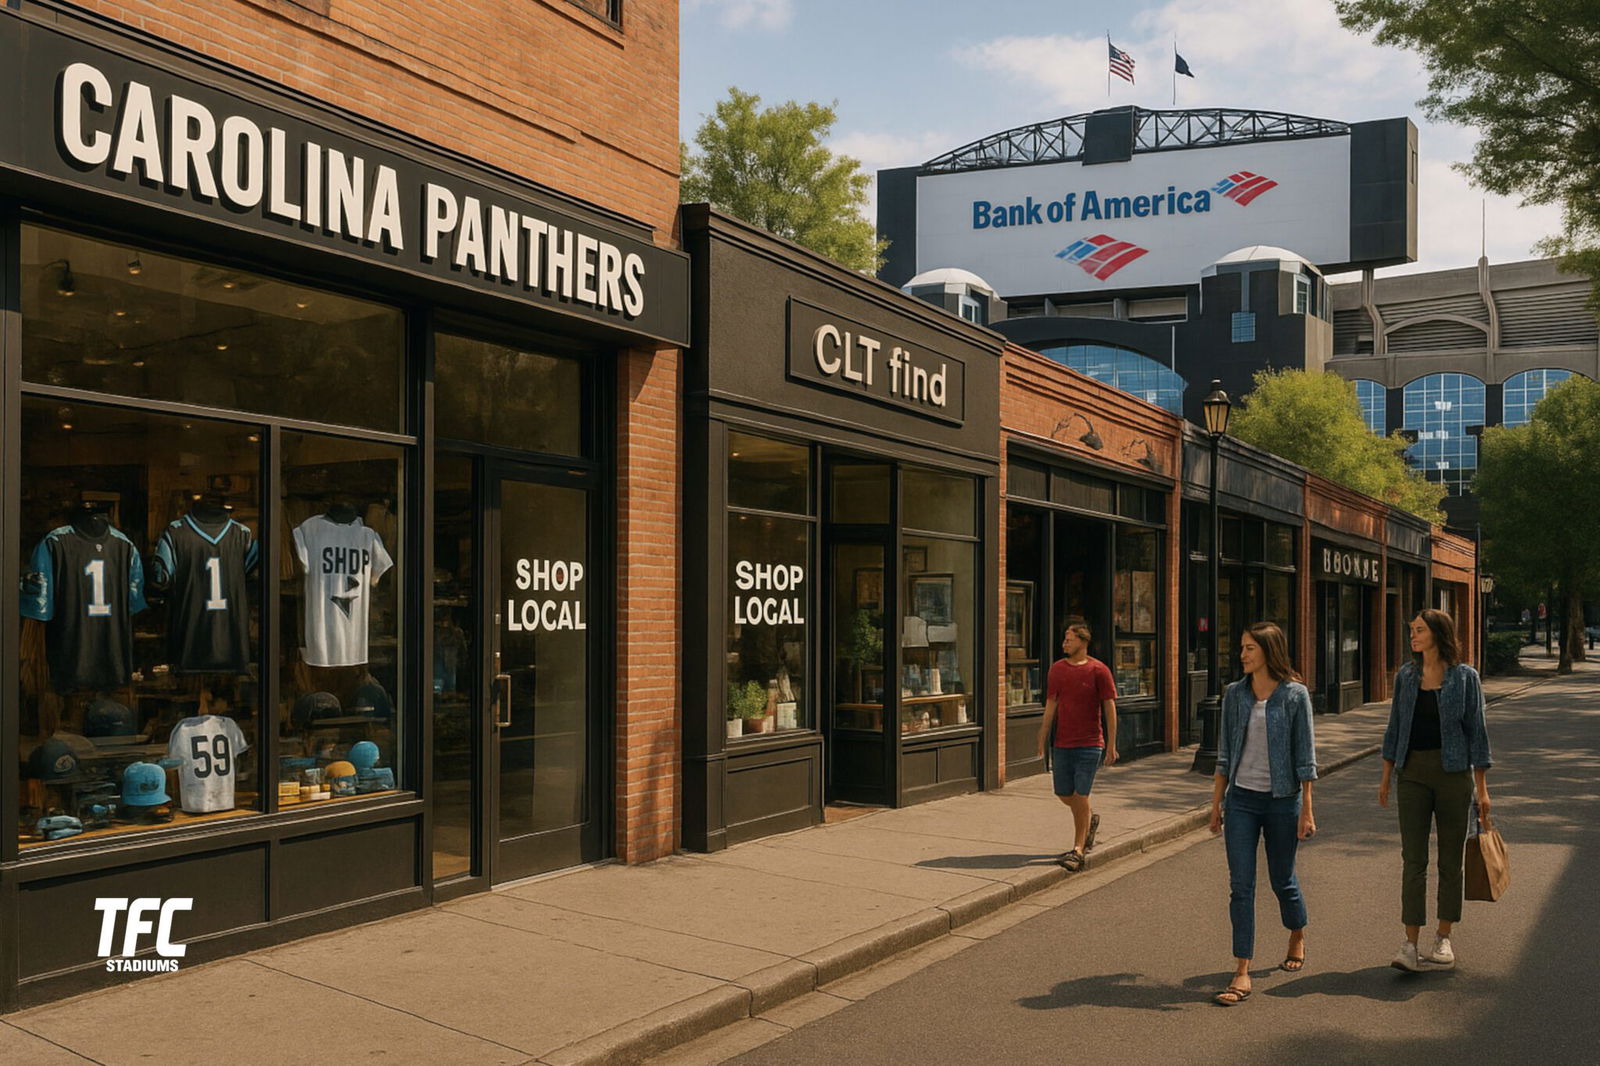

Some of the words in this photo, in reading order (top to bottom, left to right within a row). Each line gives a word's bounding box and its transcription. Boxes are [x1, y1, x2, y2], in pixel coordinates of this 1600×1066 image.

[56, 61, 405, 252] CAROLINA
[424, 182, 646, 319] PANTHERS
[973, 195, 1043, 229] Bank
[1047, 193, 1076, 222] of
[1081, 185, 1211, 220] America
[814, 324, 881, 386] CLT
[888, 347, 947, 407] find
[85, 559, 112, 616] 1
[206, 557, 227, 611] 1
[515, 558, 584, 591] SHOP
[735, 560, 804, 591] SHOP
[508, 599, 587, 631] LOCAL
[190, 734, 231, 779] 59
